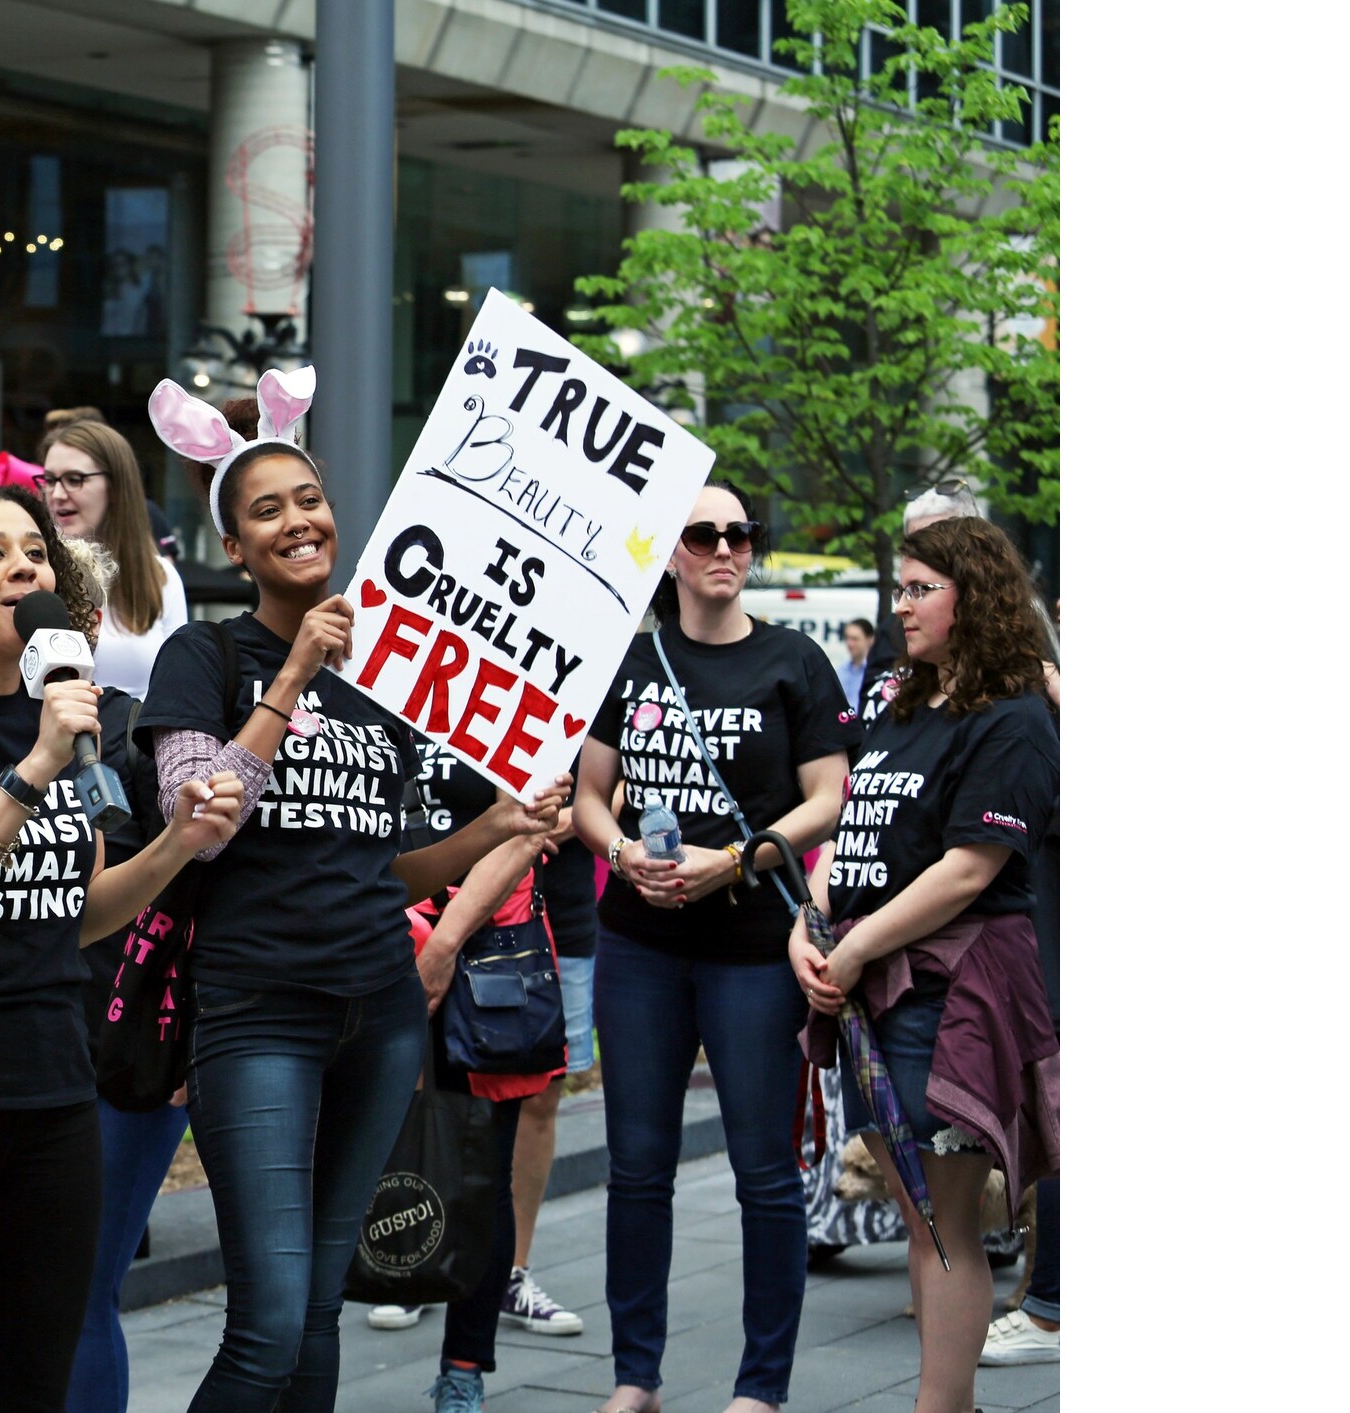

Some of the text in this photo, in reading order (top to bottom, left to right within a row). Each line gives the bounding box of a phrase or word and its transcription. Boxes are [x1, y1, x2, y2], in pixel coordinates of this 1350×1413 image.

[508, 347, 665, 495] TRUE
[442, 394, 604, 561] BEAUTY
[483, 537, 545, 607] IS
[384, 524, 583, 696] CRUELTY
[253, 680, 323, 711] I M
[356, 603, 559, 793] FREE
[623, 701, 763, 733] FREVER
[619, 727, 741, 761] AGAINST
[262, 767, 386, 806] ANIMAL
[256, 801, 393, 838] TESTING
[369, 1199, 434, 1241] GUSTO!
[421, 1219, 442, 1253] FOOD
